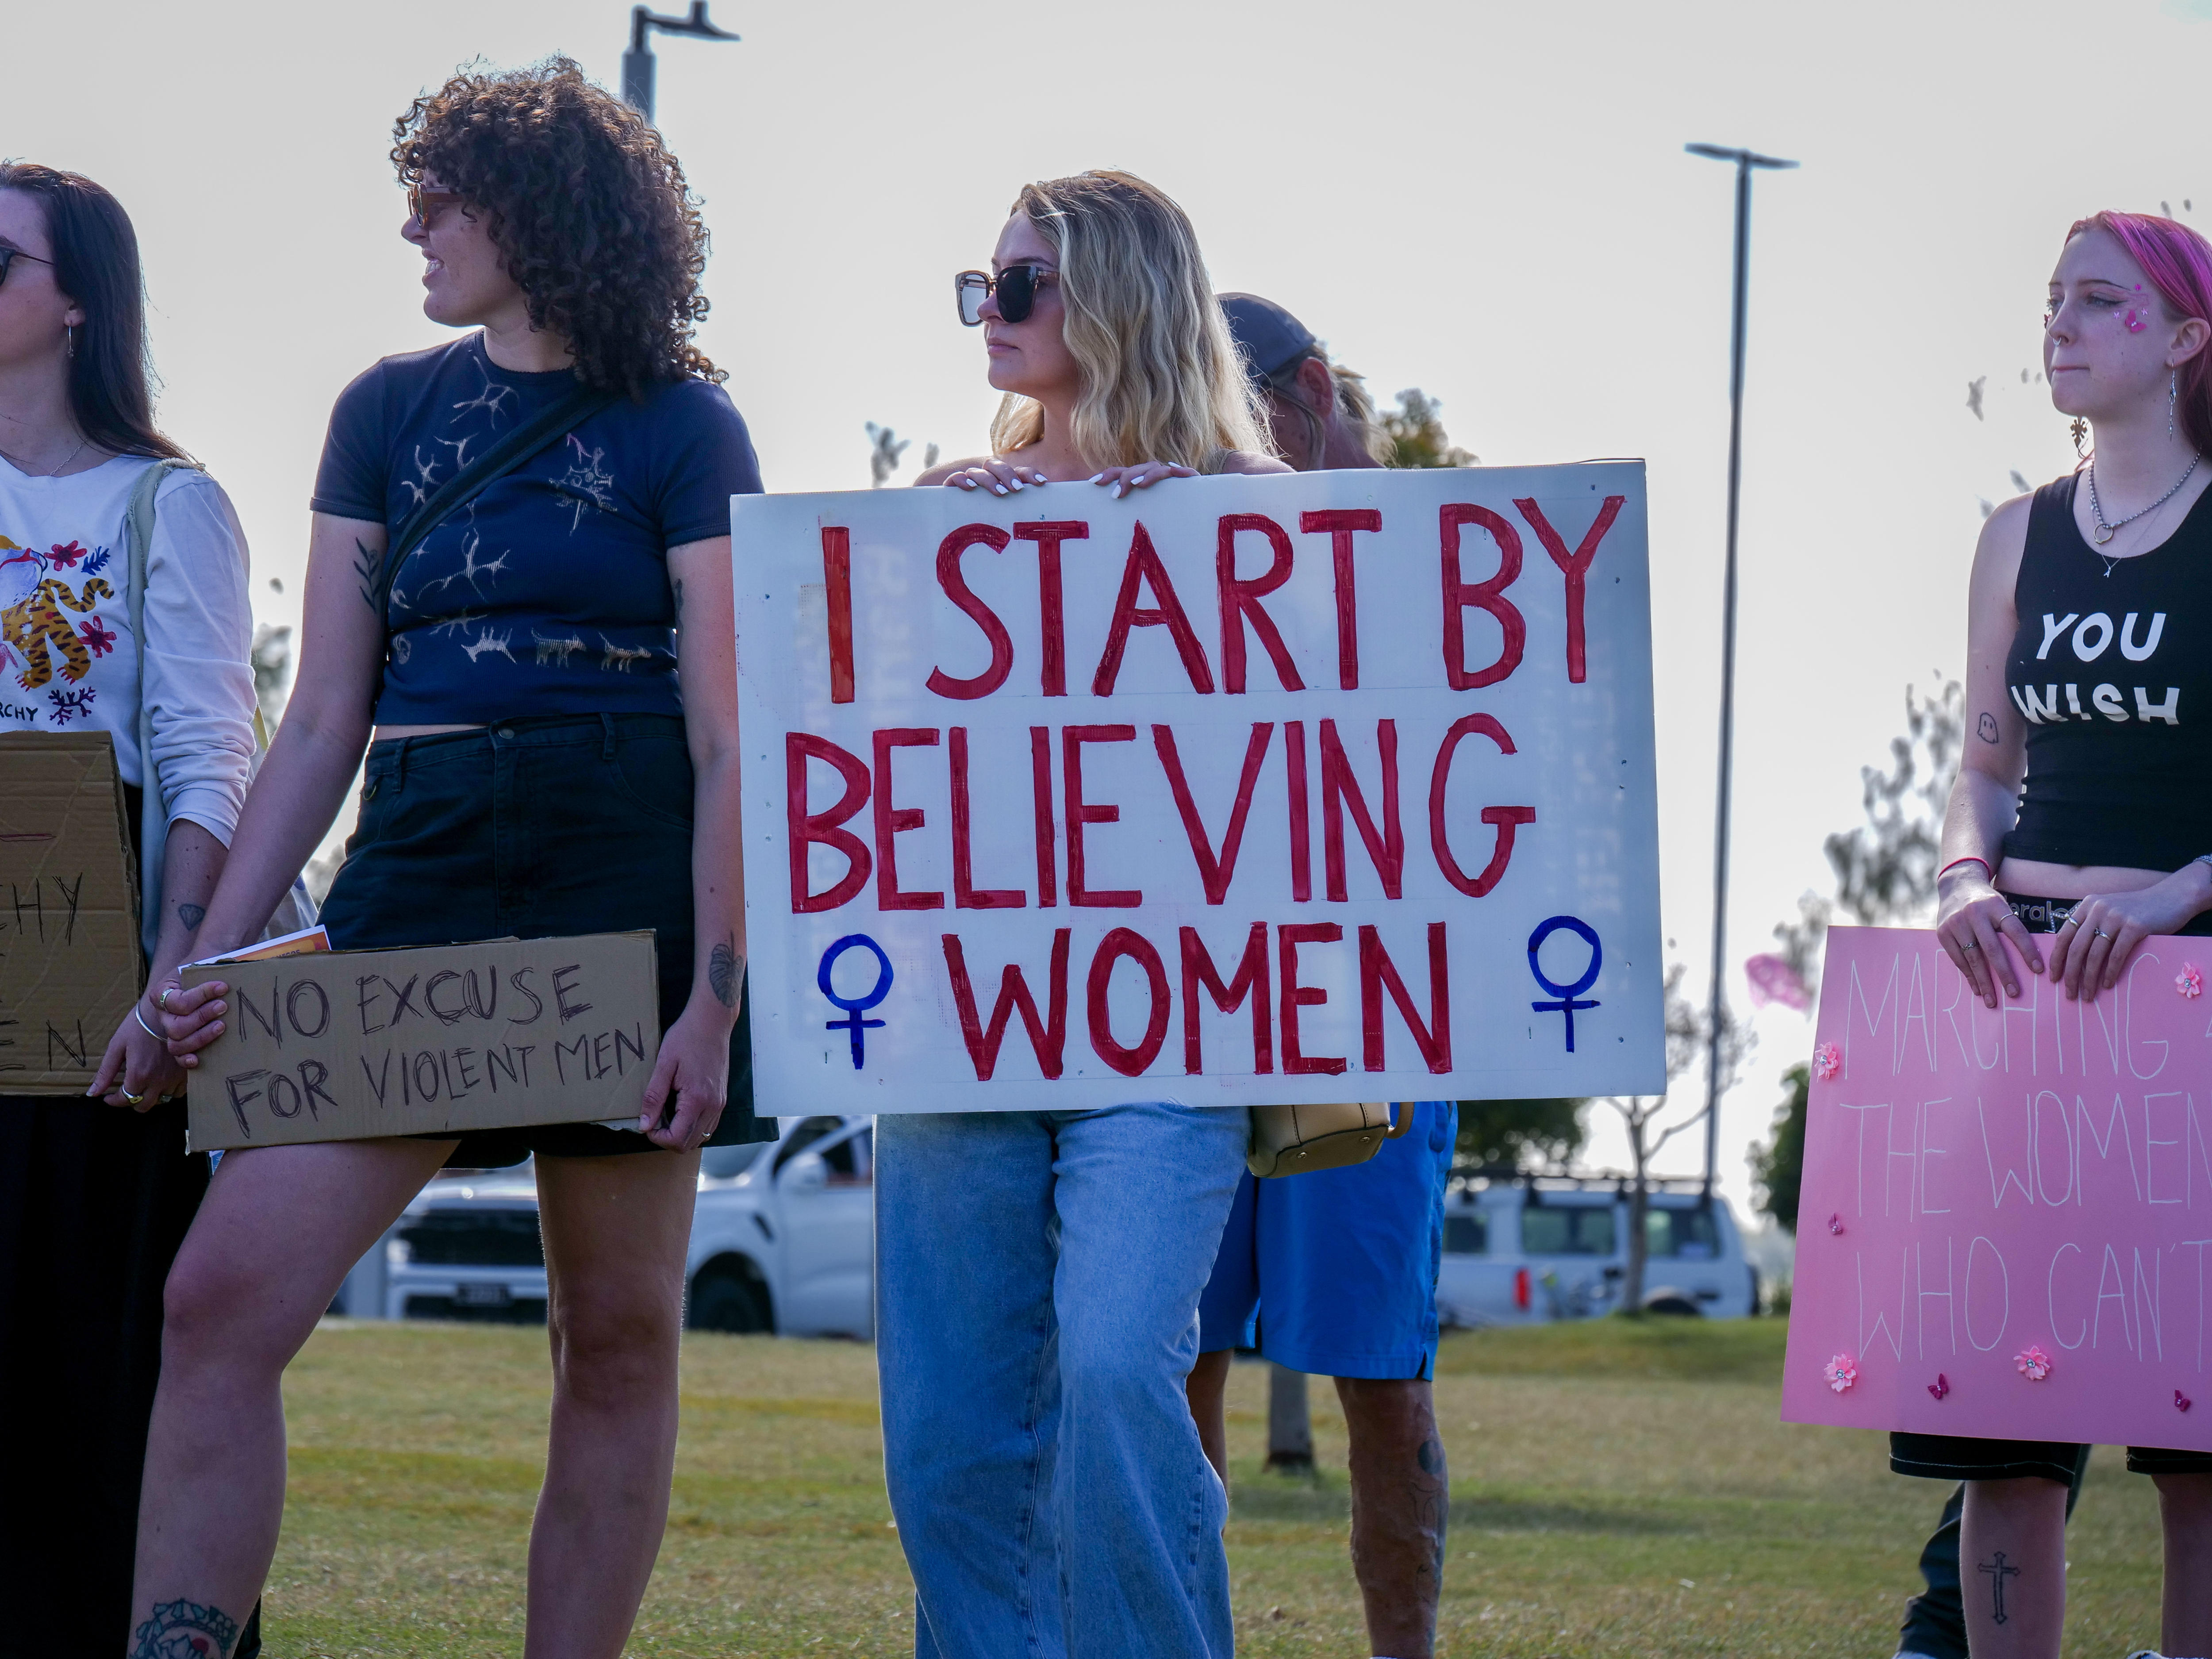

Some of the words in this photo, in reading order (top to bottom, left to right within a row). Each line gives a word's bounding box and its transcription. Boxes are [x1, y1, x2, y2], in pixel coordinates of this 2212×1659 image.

[822, 527, 855, 703] I
[926, 509, 1383, 700] START
[1440, 495, 1625, 691] BY
[2036, 613, 2166, 662] YOU
[2011, 684, 2180, 725] WISH
[787, 713, 1535, 913] BELIEVING
[237, 975, 330, 1050] NO
[356, 964, 593, 1037] EXCUSE
[942, 922, 1451, 1080] WOMEN
[1845, 949, 2169, 1080] MARCHING
[225, 1059, 338, 1139] FOR
[360, 1043, 536, 1109] VIOLENT
[555, 1022, 646, 1086] MEN
[1839, 1097, 1952, 1223] THE
[1978, 1090, 2212, 1210] WOMEN
[1857, 1236, 2008, 1363] WHO
[2049, 1239, 2212, 1373] CAN'T
